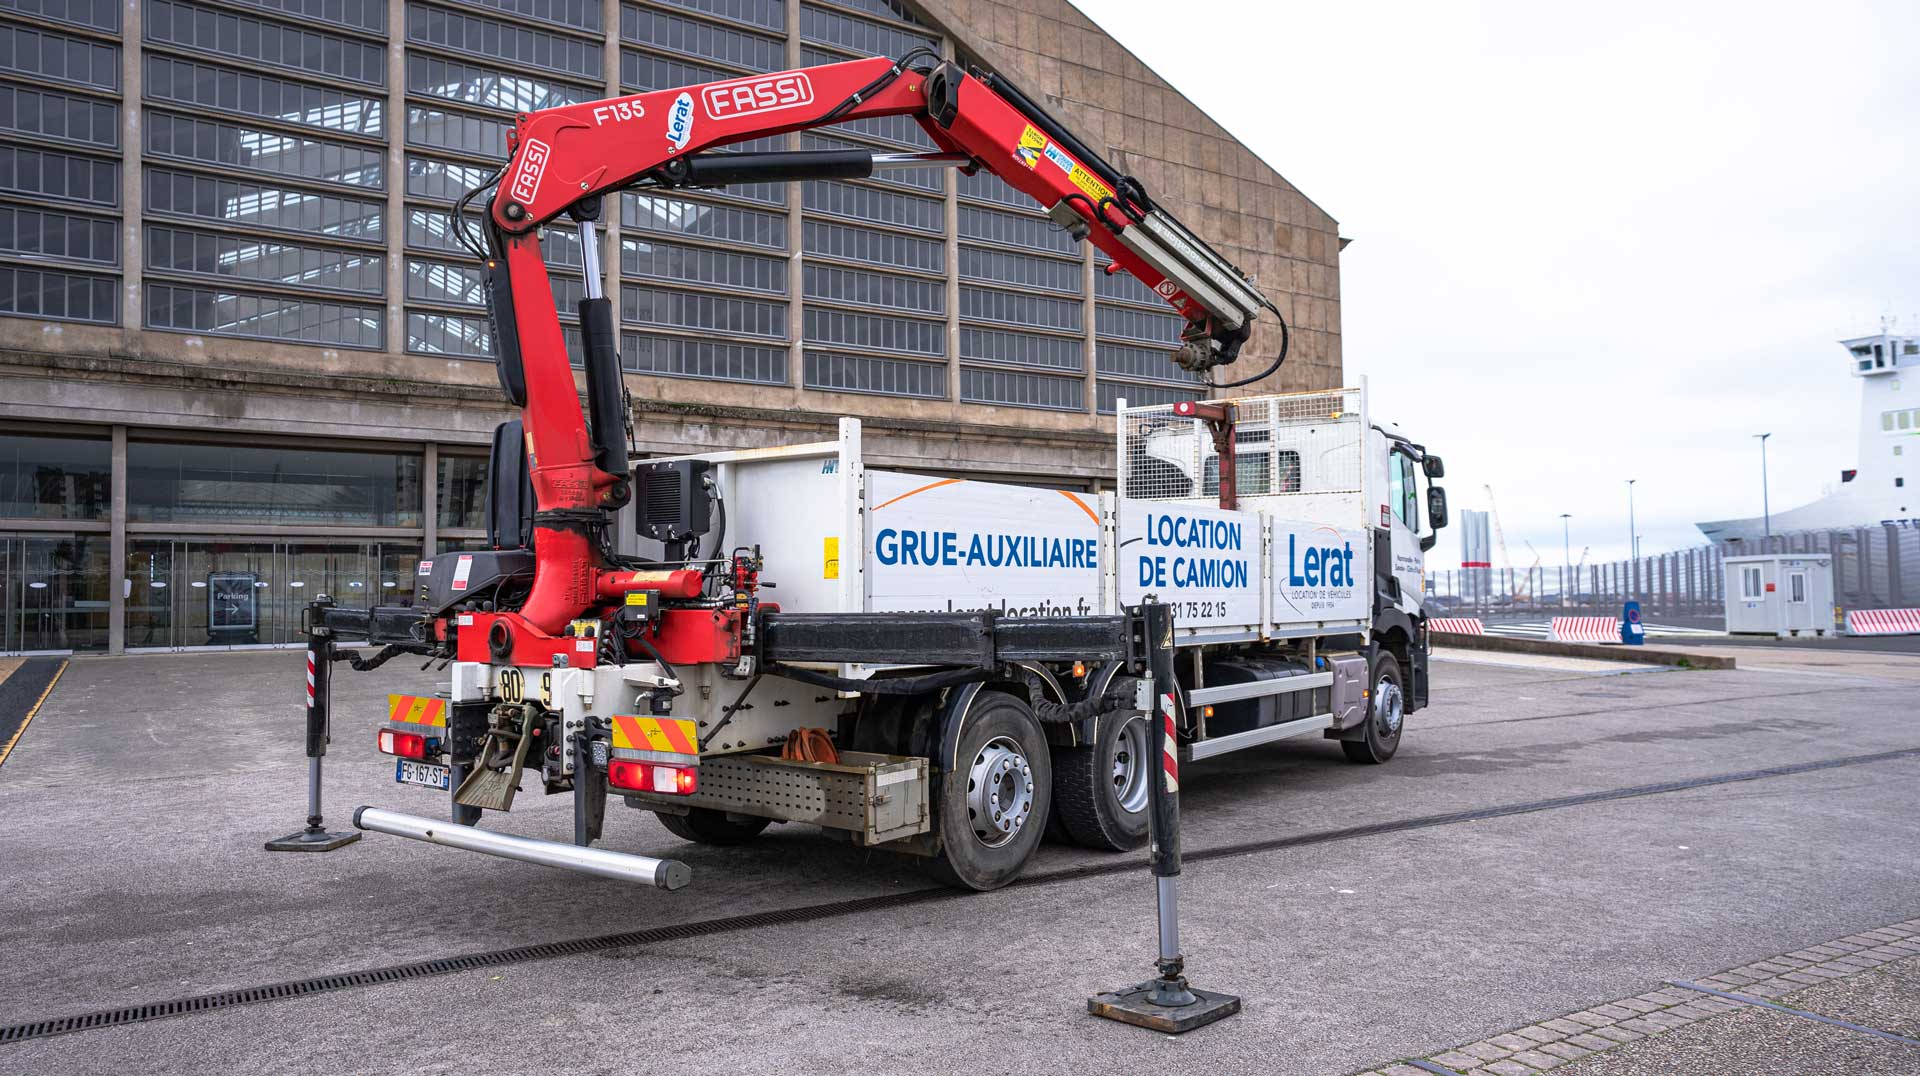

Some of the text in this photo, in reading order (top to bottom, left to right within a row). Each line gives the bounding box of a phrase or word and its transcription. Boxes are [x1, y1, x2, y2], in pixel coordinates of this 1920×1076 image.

[710, 78, 807, 114] FASSI
[593, 100, 645, 126] F135
[668, 98, 690, 142] Lerat
[517, 145, 544, 198] FASSI
[1073, 167, 1110, 197] ATTENTION
[875, 528, 1098, 569] GRUE-AUXILIAIRE
[1148, 513, 1241, 551] LOCATION
[1139, 555, 1248, 588] DE CAMION
[1289, 533, 1354, 587] Lerat
[217, 592, 249, 602] Parking
[1171, 601, 1226, 618] 31 75 22 15
[1292, 590, 1317, 600] LOCATION
[1319, 590, 1326, 599] DE
[501, 669, 520, 703] 80
[401, 762, 444, 785] FG-167-ST
